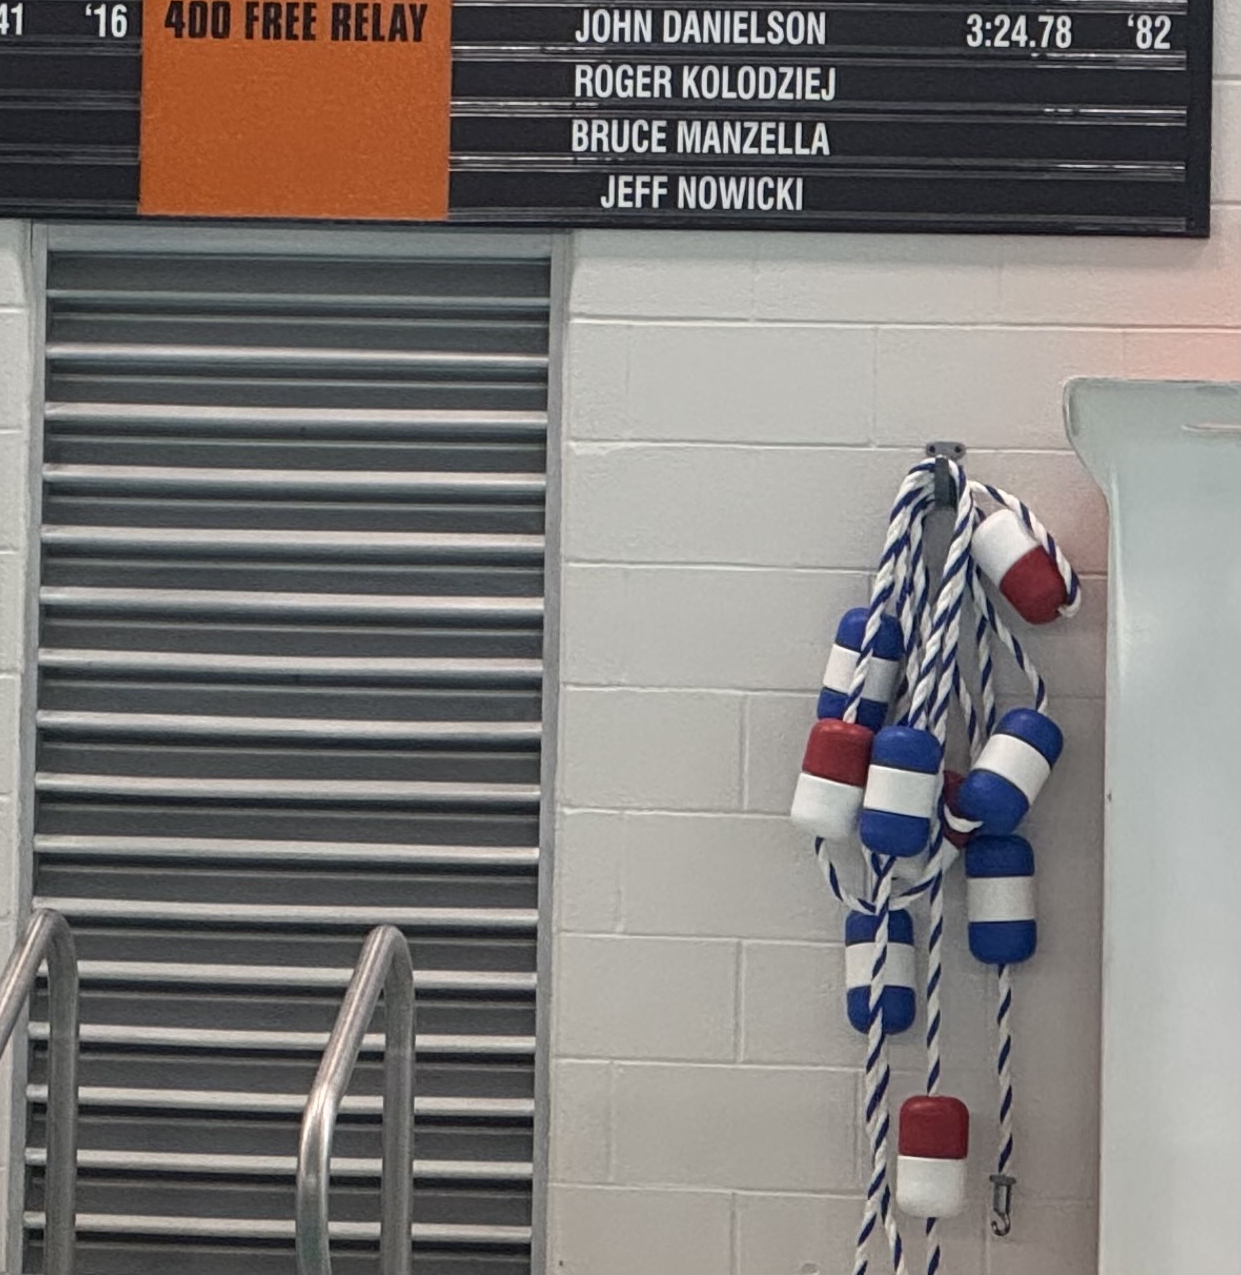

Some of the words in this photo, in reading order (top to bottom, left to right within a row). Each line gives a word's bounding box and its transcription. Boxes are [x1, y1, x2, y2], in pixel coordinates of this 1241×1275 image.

[163, 0, 232, 40] 400
[244, 0, 318, 42] FREE
[330, 1, 429, 43] RELAY
[575, 8, 652, 44] JOHN
[662, 10, 826, 45] DANIELSON
[966, 13, 1072, 49] 3:24.78
